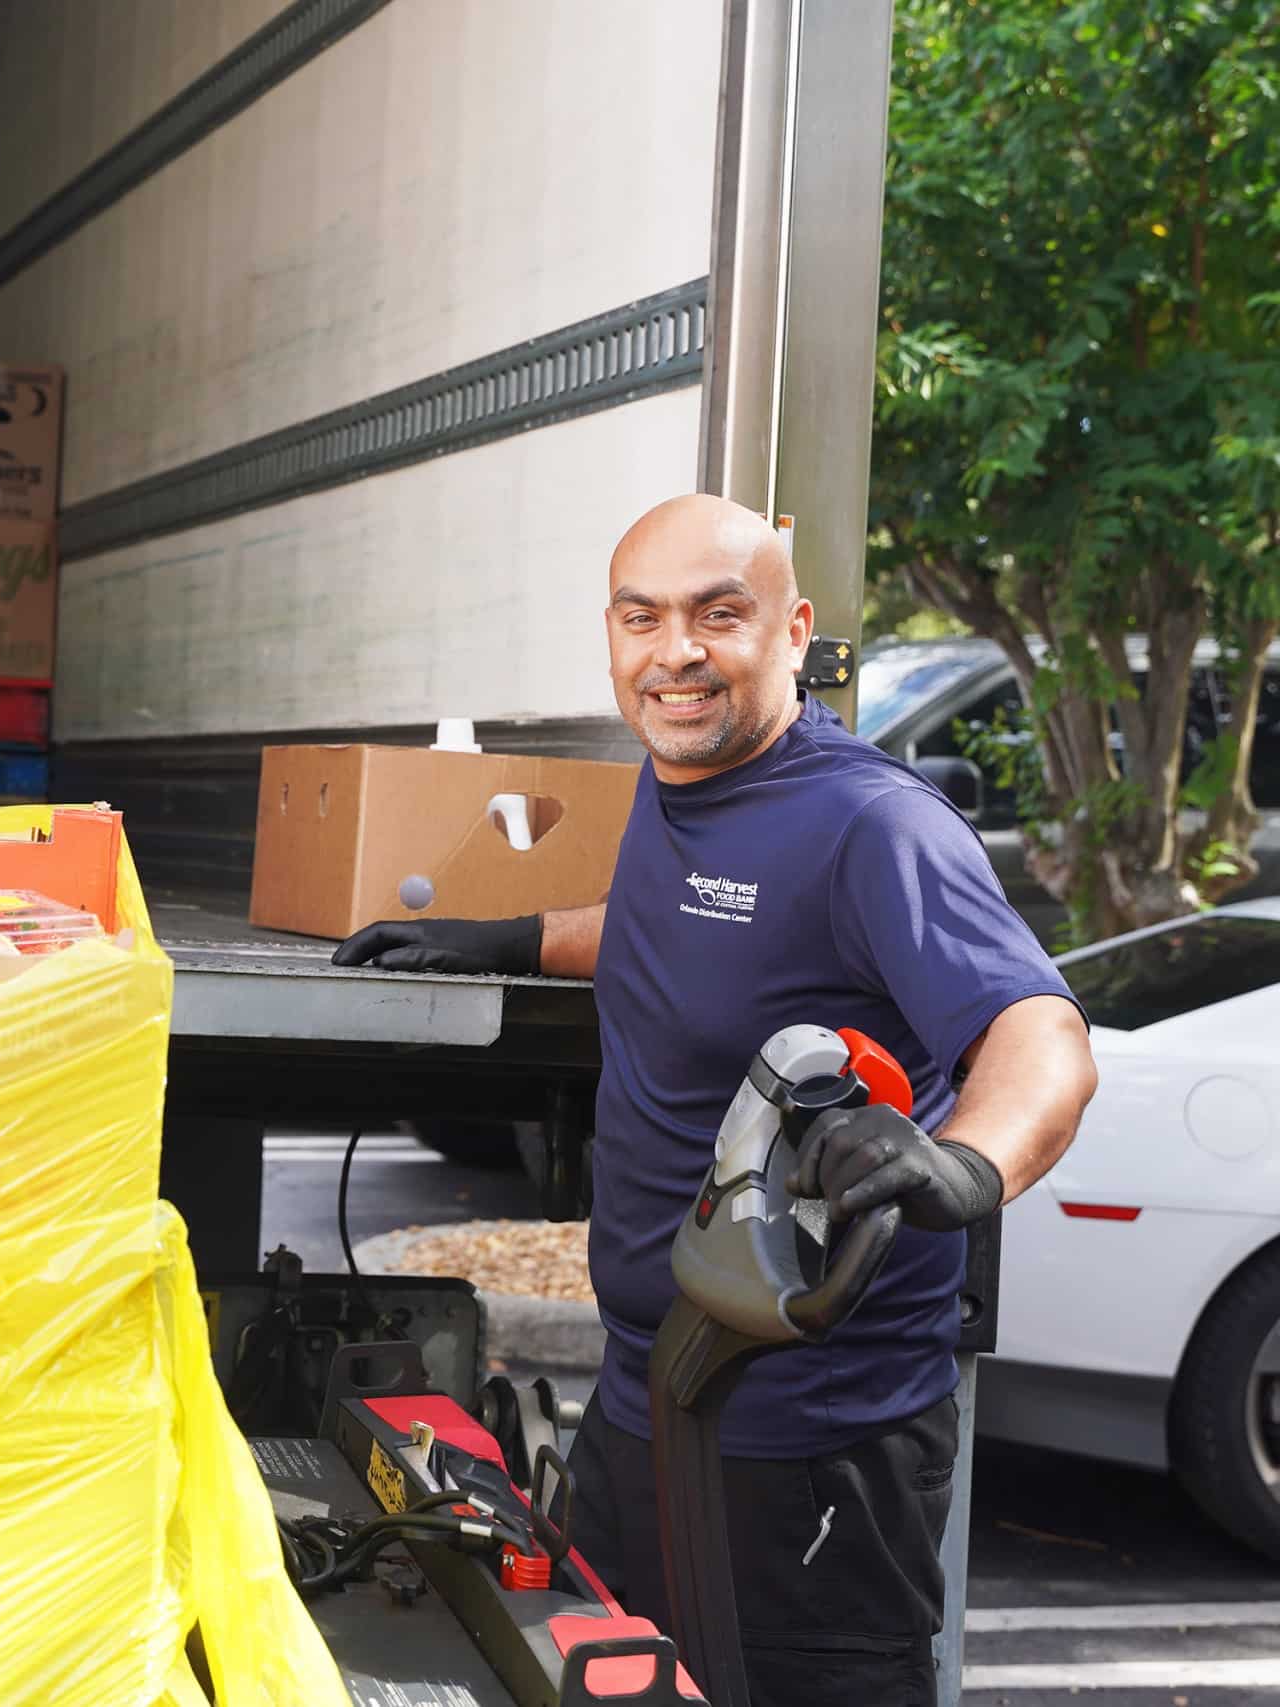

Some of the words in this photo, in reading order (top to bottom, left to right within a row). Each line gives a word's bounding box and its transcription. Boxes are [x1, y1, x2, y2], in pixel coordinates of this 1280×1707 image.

[687, 872, 722, 891] Second
[721, 877, 759, 896] Harvest
[716, 892, 735, 901] FOOD
